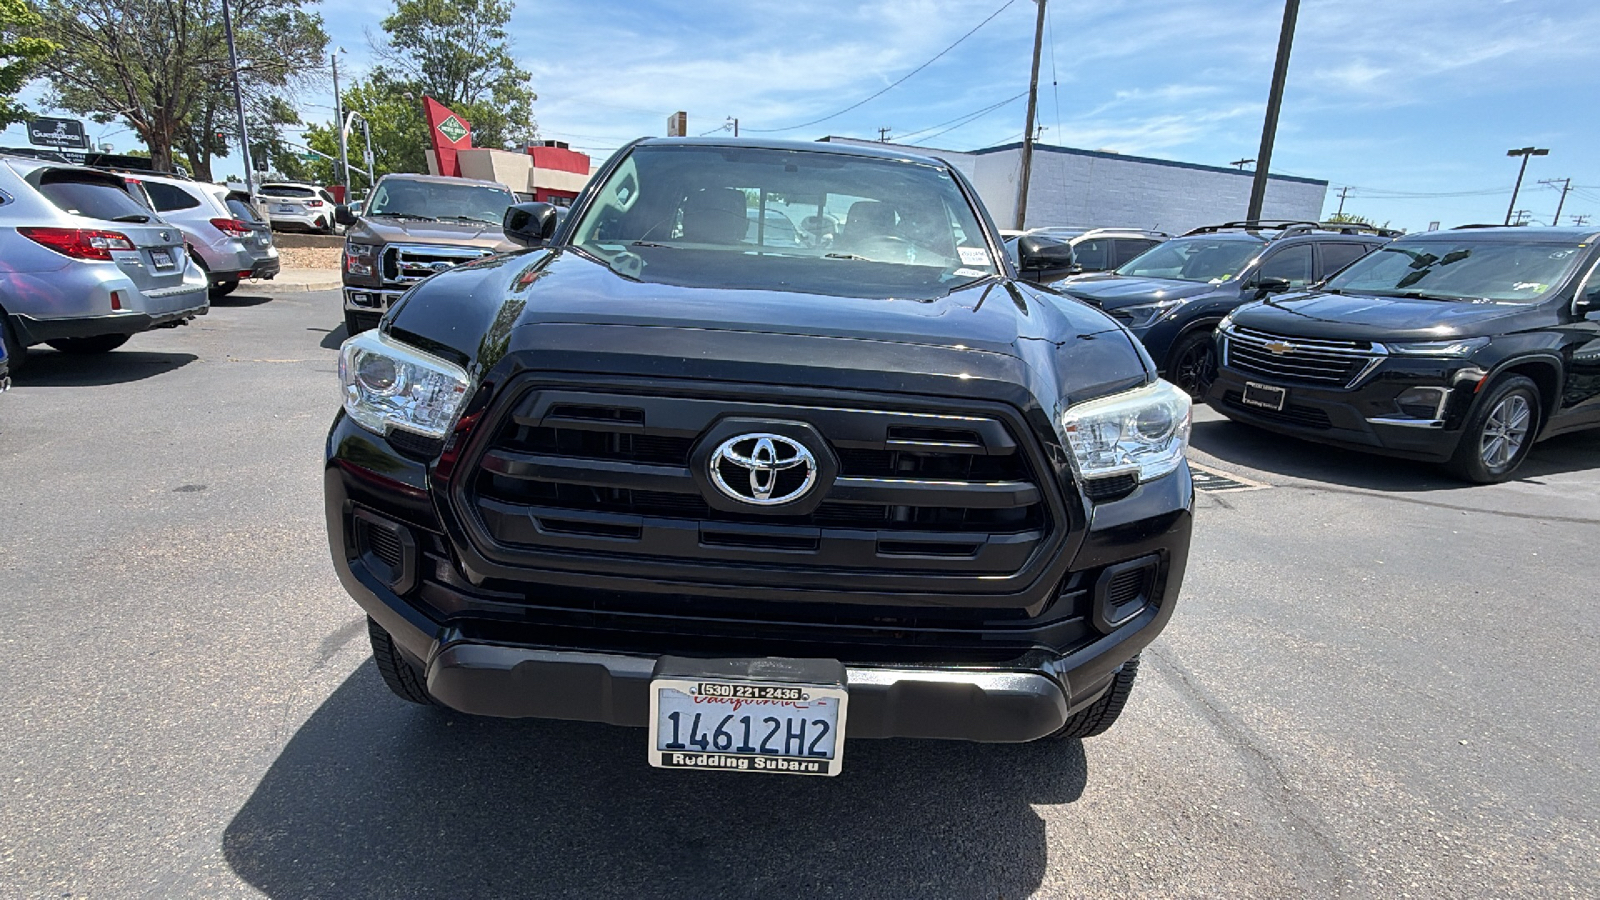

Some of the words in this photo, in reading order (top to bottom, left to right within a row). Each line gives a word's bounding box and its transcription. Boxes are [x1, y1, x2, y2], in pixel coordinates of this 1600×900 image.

[701, 683, 734, 697] (530)
[736, 686, 799, 699] 221-2436
[665, 711, 830, 757] 14612H2
[672, 753, 749, 769] Redding
[754, 757, 819, 771] Subaru
